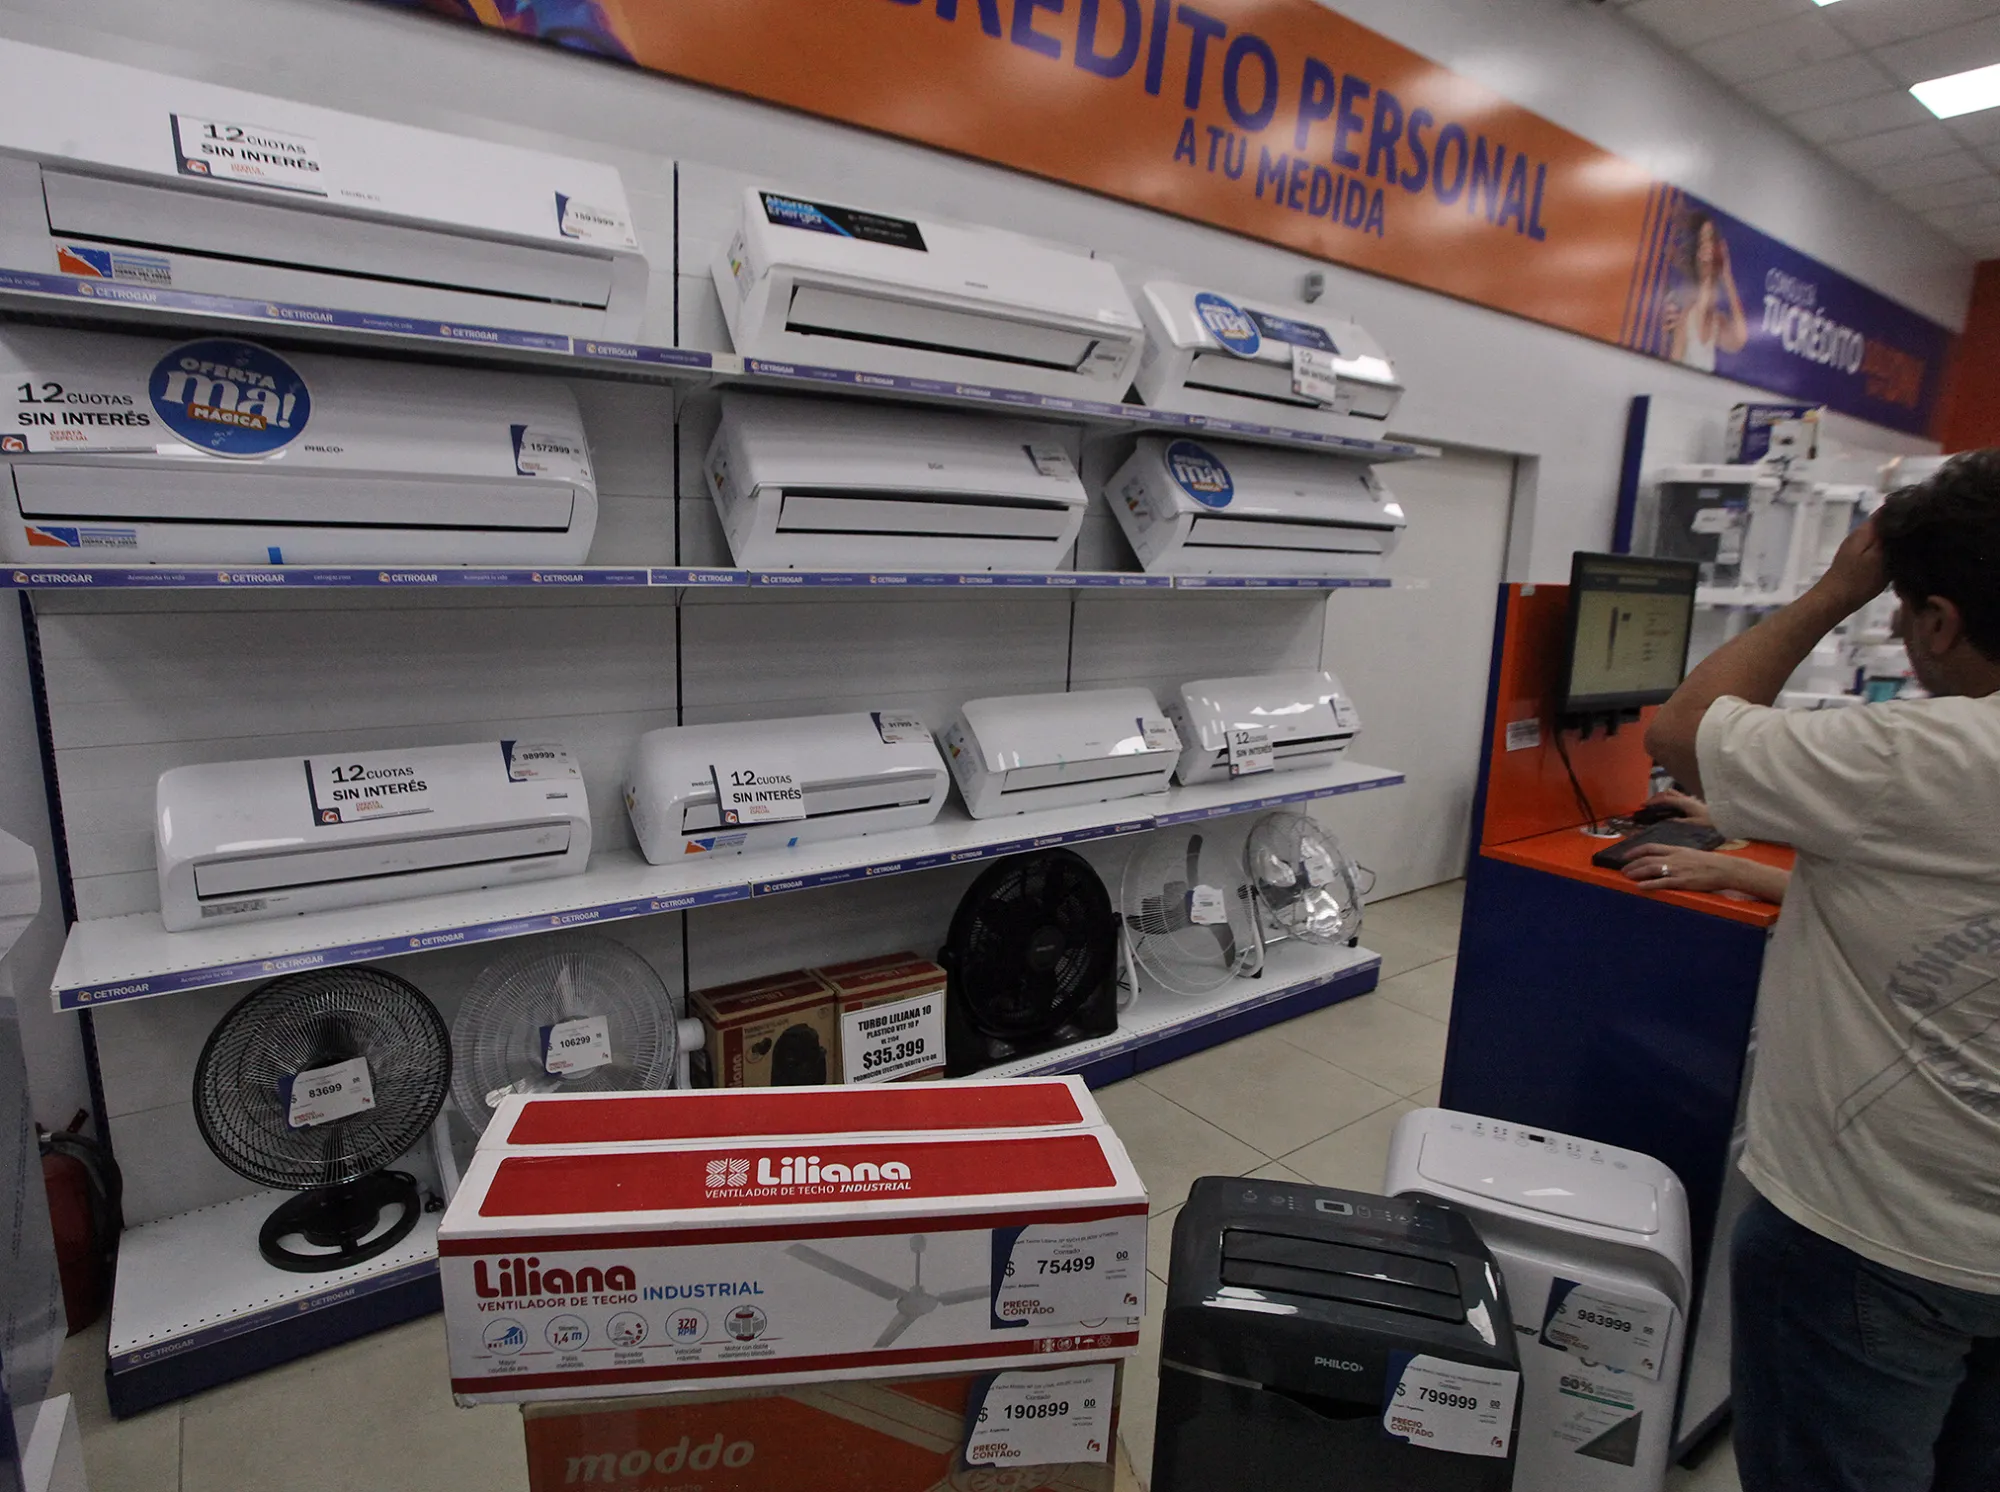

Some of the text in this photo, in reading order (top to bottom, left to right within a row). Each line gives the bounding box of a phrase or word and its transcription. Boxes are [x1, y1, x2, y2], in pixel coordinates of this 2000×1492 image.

[203, 123, 307, 155] 12 CUOTAS
[200, 143, 235, 159] SIN
[241, 149, 320, 172] INTERÉS
[1294, 57, 1548, 242] PERSONAL
[1173, 115, 1386, 239] A TU MEDIDA
[95, 285, 158, 304] CETROGAR
[281, 307, 334, 324] CETROGAR
[452, 327, 499, 342] CETROGAR
[597, 345, 639, 359] CETROGAR
[179, 357, 277, 390] OFERTA
[17, 382, 133, 406] 12 CUOTAS
[18, 410, 151, 427] SIN INTERÉS
[193, 406, 265, 430] MÁGICA
[31, 573, 93, 583] CETROGAR
[232, 573, 285, 583] CETROGAR
[391, 573, 438, 583] CETROGAR
[543, 573, 584, 583] CETROGAR
[698, 574, 734, 583] CETROGAR
[770, 575, 803, 584] CETROGAR
[331, 764, 415, 783] 12 CUOTAS
[730, 770, 793, 787] 12 CUOTAS
[332, 780, 428, 802] SIN INTERÉS
[732, 787, 802, 803] SIN INTERÉS
[771, 880, 803, 892] CETROGAR
[660, 897, 695, 909] CETROGAR
[561, 910, 600, 925] CETROGAR
[421, 932, 465, 947] CETROGAR
[275, 955, 324, 970] CETROGAR
[93, 983, 150, 1000] CETROGAR
[858, 1004, 932, 1032] TURBO LILIANA 10
[866, 1025, 895, 1040] PLASTICO
[559, 1035, 591, 1049] 106299
[862, 1037, 925, 1071] $35.399
[308, 1083, 343, 1098] 83699
[757, 1156, 912, 1186] Liliana
[705, 1181, 912, 1199] VENTILADOR DE TECHO INDUSTRIAL
[1053, 1248, 1081, 1256] Contado
[1004, 1261, 1016, 1278] $
[1037, 1255, 1096, 1275] 75499
[1116, 1250, 1129, 1260] 00
[473, 1257, 637, 1299] Liliana
[643, 1281, 765, 1301] INDUSTRIAL
[477, 1294, 639, 1312] VENTILADOR DE TECHO
[1003, 1299, 1041, 1309] PRECIO
[1003, 1306, 1055, 1316] CONTADO
[677, 1317, 698, 1330] 320
[1577, 1309, 1633, 1333] 983999
[553, 1331, 583, 1346] 1,4 m
[677, 1327, 697, 1337] RPM
[143, 1338, 195, 1360] CETROGAR
[1314, 1356, 1359, 1372] PHILCO
[1418, 1387, 1478, 1411] 799999
[978, 1398, 1096, 1423] $ 190899 00
[1390, 1416, 1423, 1429] PRECIO
[1390, 1423, 1435, 1439] CONTADO
[972, 1450, 1021, 1460] CONTADO
[973, 1443, 1009, 1453] PRECIO
[565, 1433, 755, 1484] moddo
